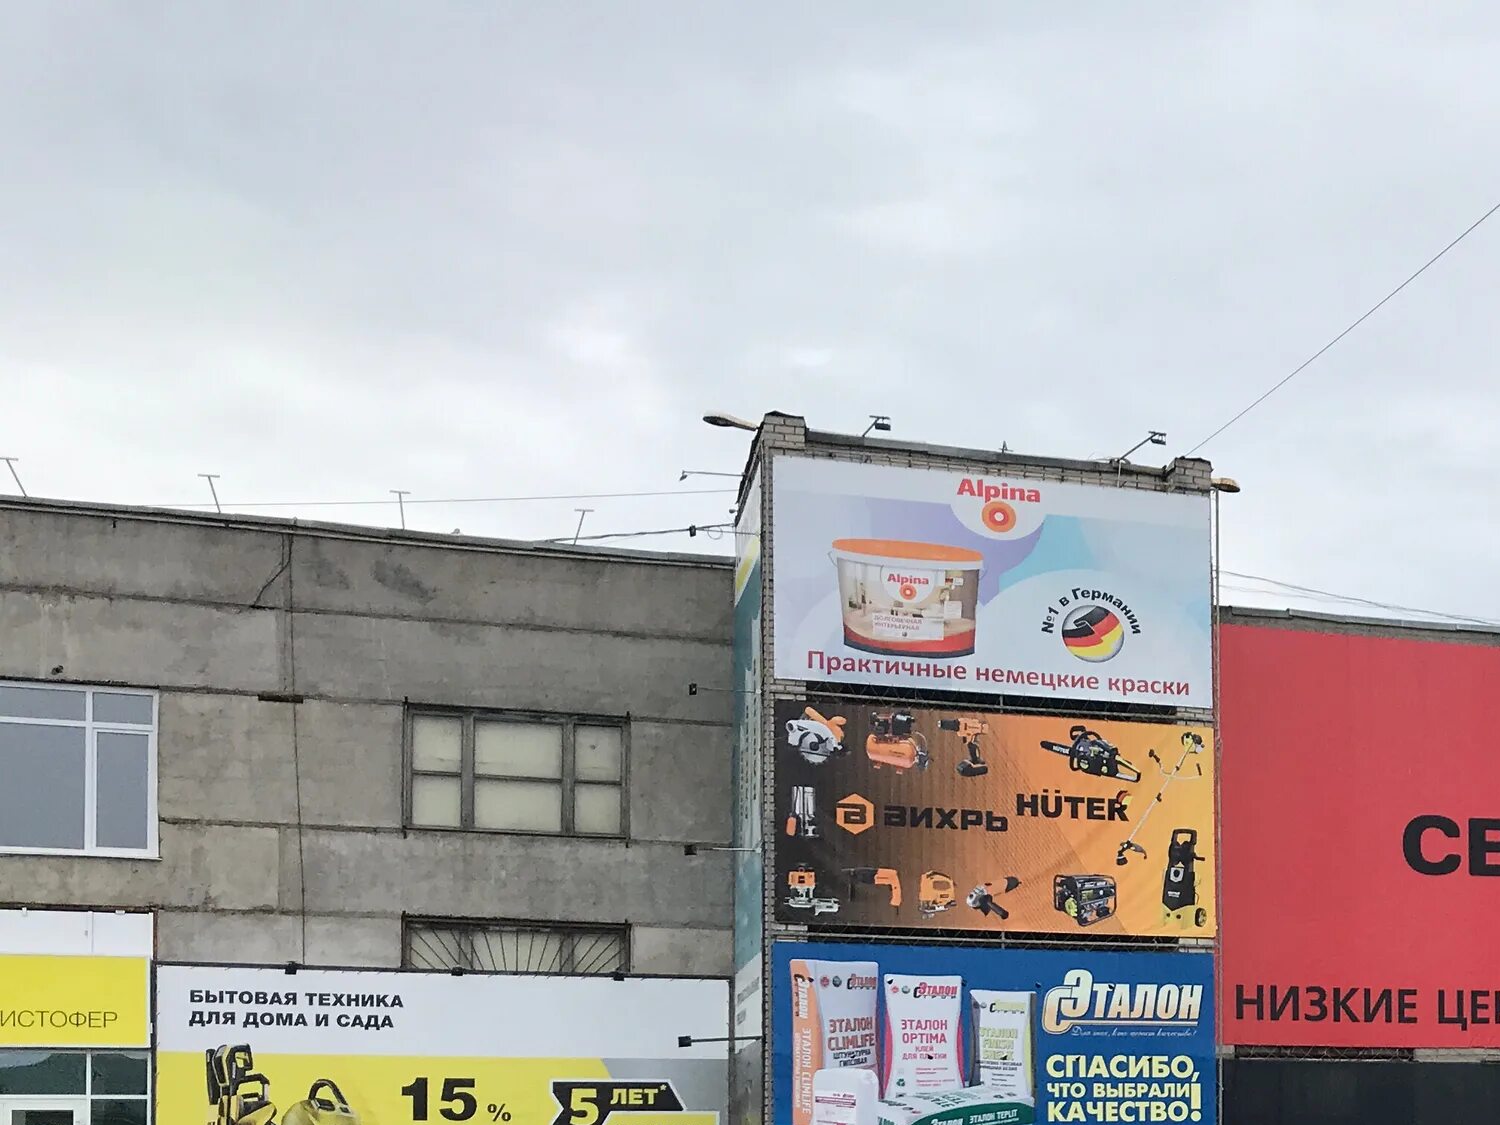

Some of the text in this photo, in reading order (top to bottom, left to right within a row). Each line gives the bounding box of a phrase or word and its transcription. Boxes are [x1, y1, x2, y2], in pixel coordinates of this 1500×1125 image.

[957, 478, 1041, 503] Alpina
[887, 573, 929, 586] Alpina
[1041, 587, 1141, 635] №1 в Германии
[807, 650, 1190, 696] Практичные немецкие краски
[1015, 788, 1130, 822] HÜTER
[884, 804, 1008, 832] ВИХРЬ
[189, 989, 404, 1008] БЫТОВАЯ ТЕХНИКА
[1235, 984, 1418, 1024] НИЗКИЕ
[0, 1009, 118, 1028] ИСТОФЕР
[189, 1011, 394, 1030] ДЛЯ ДОМА И САДА
[829, 1017, 874, 1034] ЭТАЛОН
[901, 1019, 948, 1031] ЭТАЛОН
[902, 1032, 947, 1045] OPTIMA
[1046, 1054, 1200, 1082] СПАСИБО,
[401, 1077, 512, 1122] 15 %
[1046, 1082, 1190, 1099] ЧТО ВЫБРАЛИ
